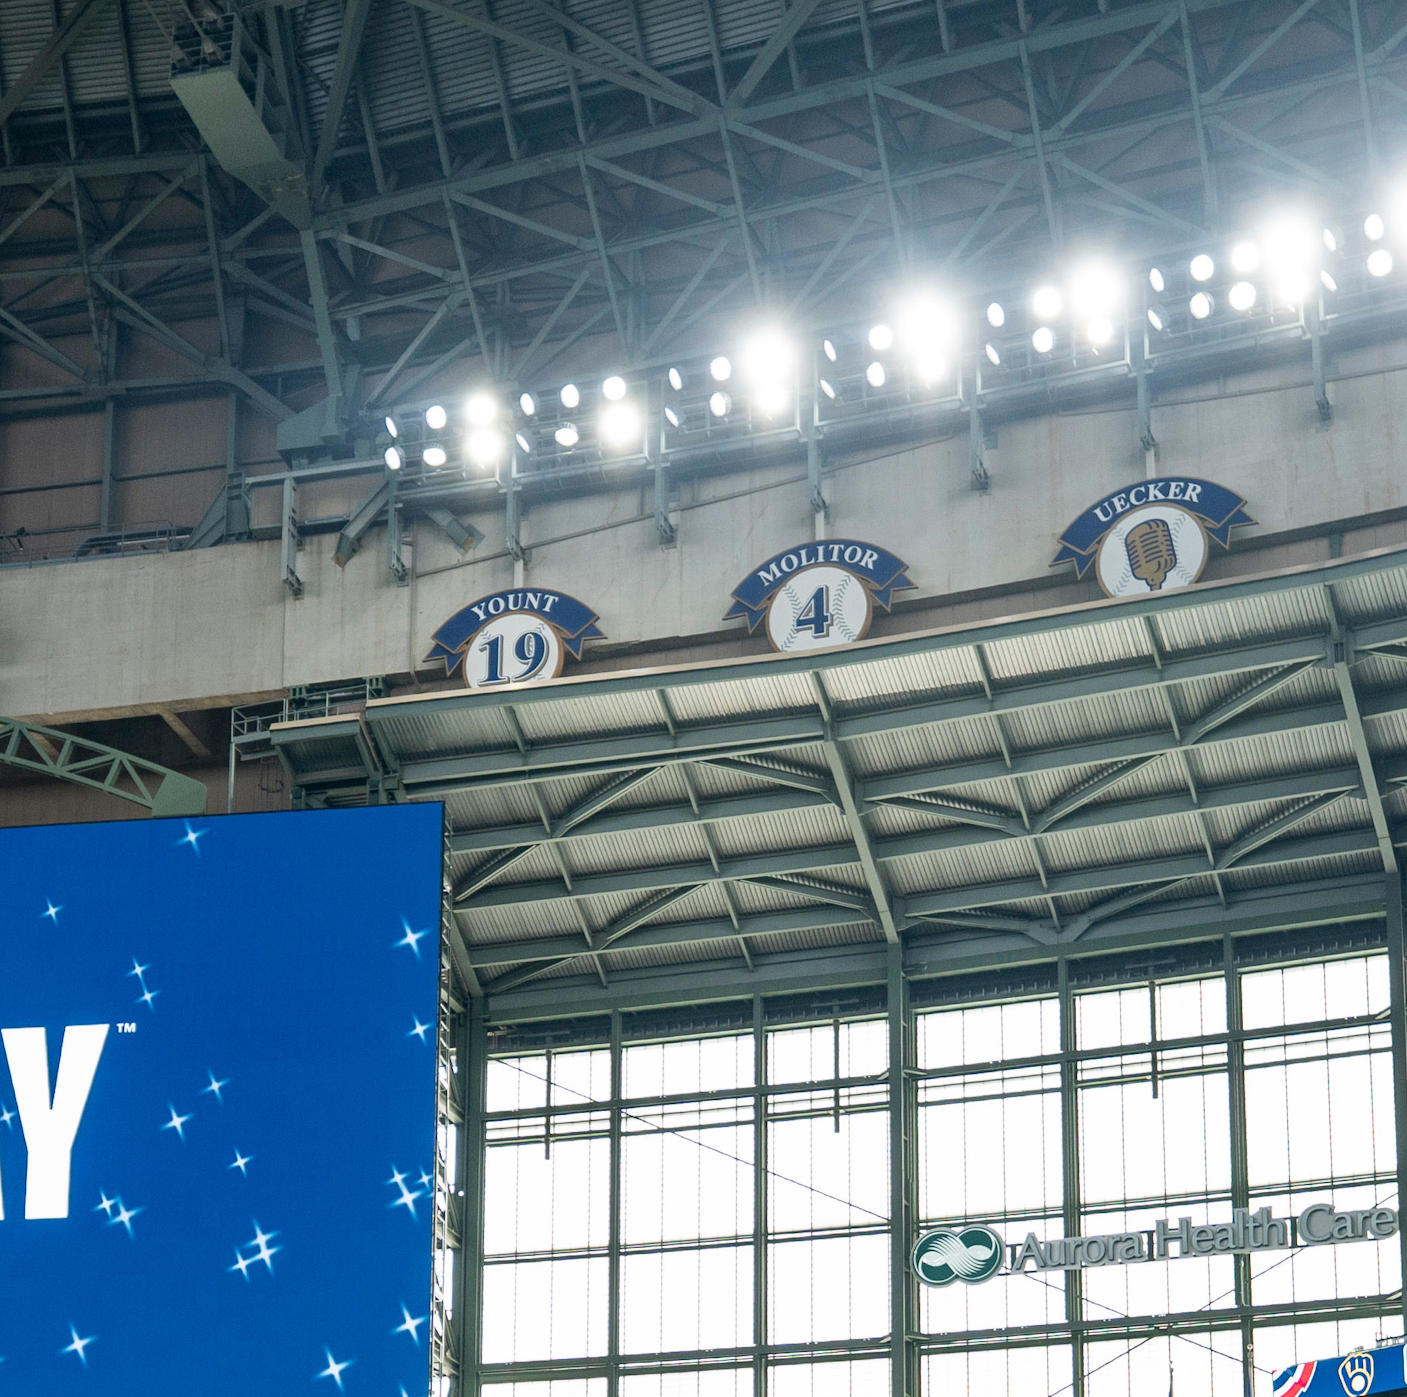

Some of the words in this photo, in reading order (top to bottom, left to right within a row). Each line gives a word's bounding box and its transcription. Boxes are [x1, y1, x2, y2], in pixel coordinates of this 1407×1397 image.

[1093, 481, 1202, 523] UECKER
[756, 544, 879, 587] MOLITOR
[471, 592, 559, 622] YOUNT
[794, 584, 834, 639] 4
[478, 631, 549, 686] 19
[1011, 1230, 1148, 1274] Aurora
[1155, 1205, 1289, 1261] Health
[1298, 1202, 1399, 1246] Care
